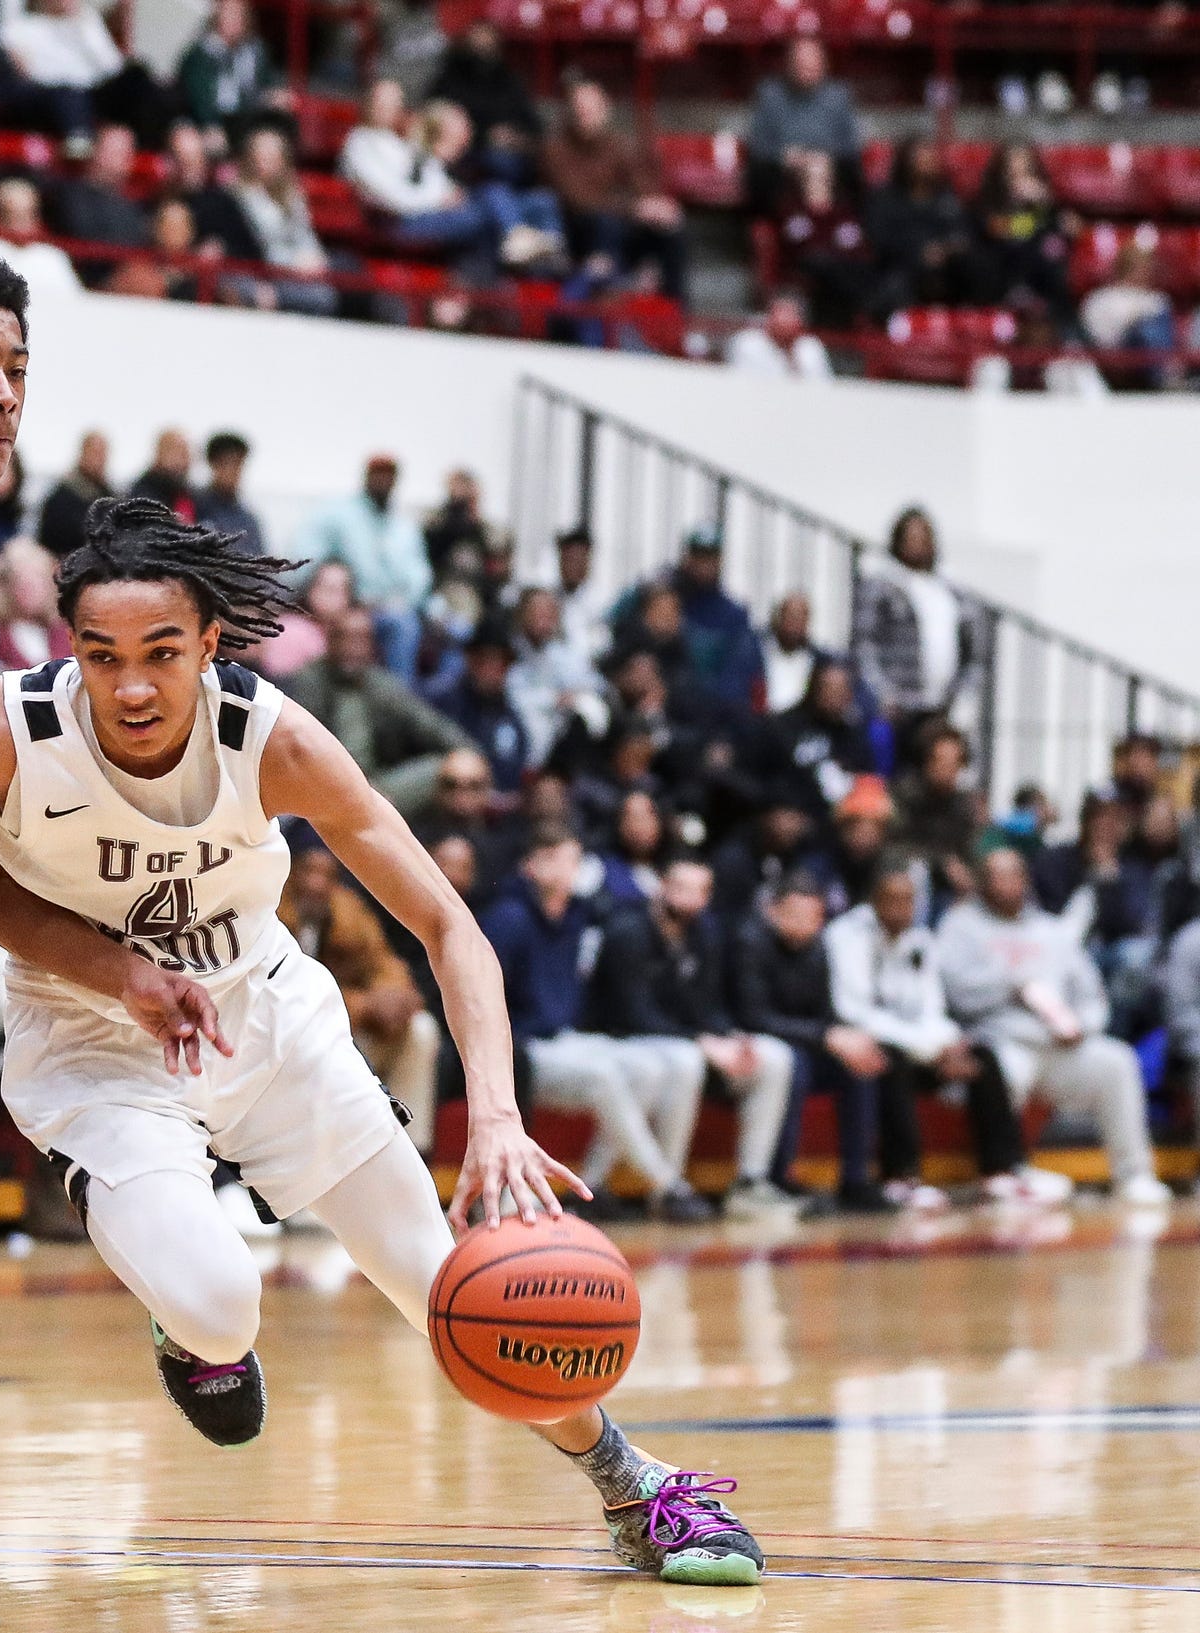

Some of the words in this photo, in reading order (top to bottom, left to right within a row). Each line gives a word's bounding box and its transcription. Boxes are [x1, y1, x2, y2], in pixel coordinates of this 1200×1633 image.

[96, 836, 140, 882] U
[146, 851, 188, 874] OF
[124, 877, 199, 939] 4
[497, 1333, 625, 1382] Wilson
